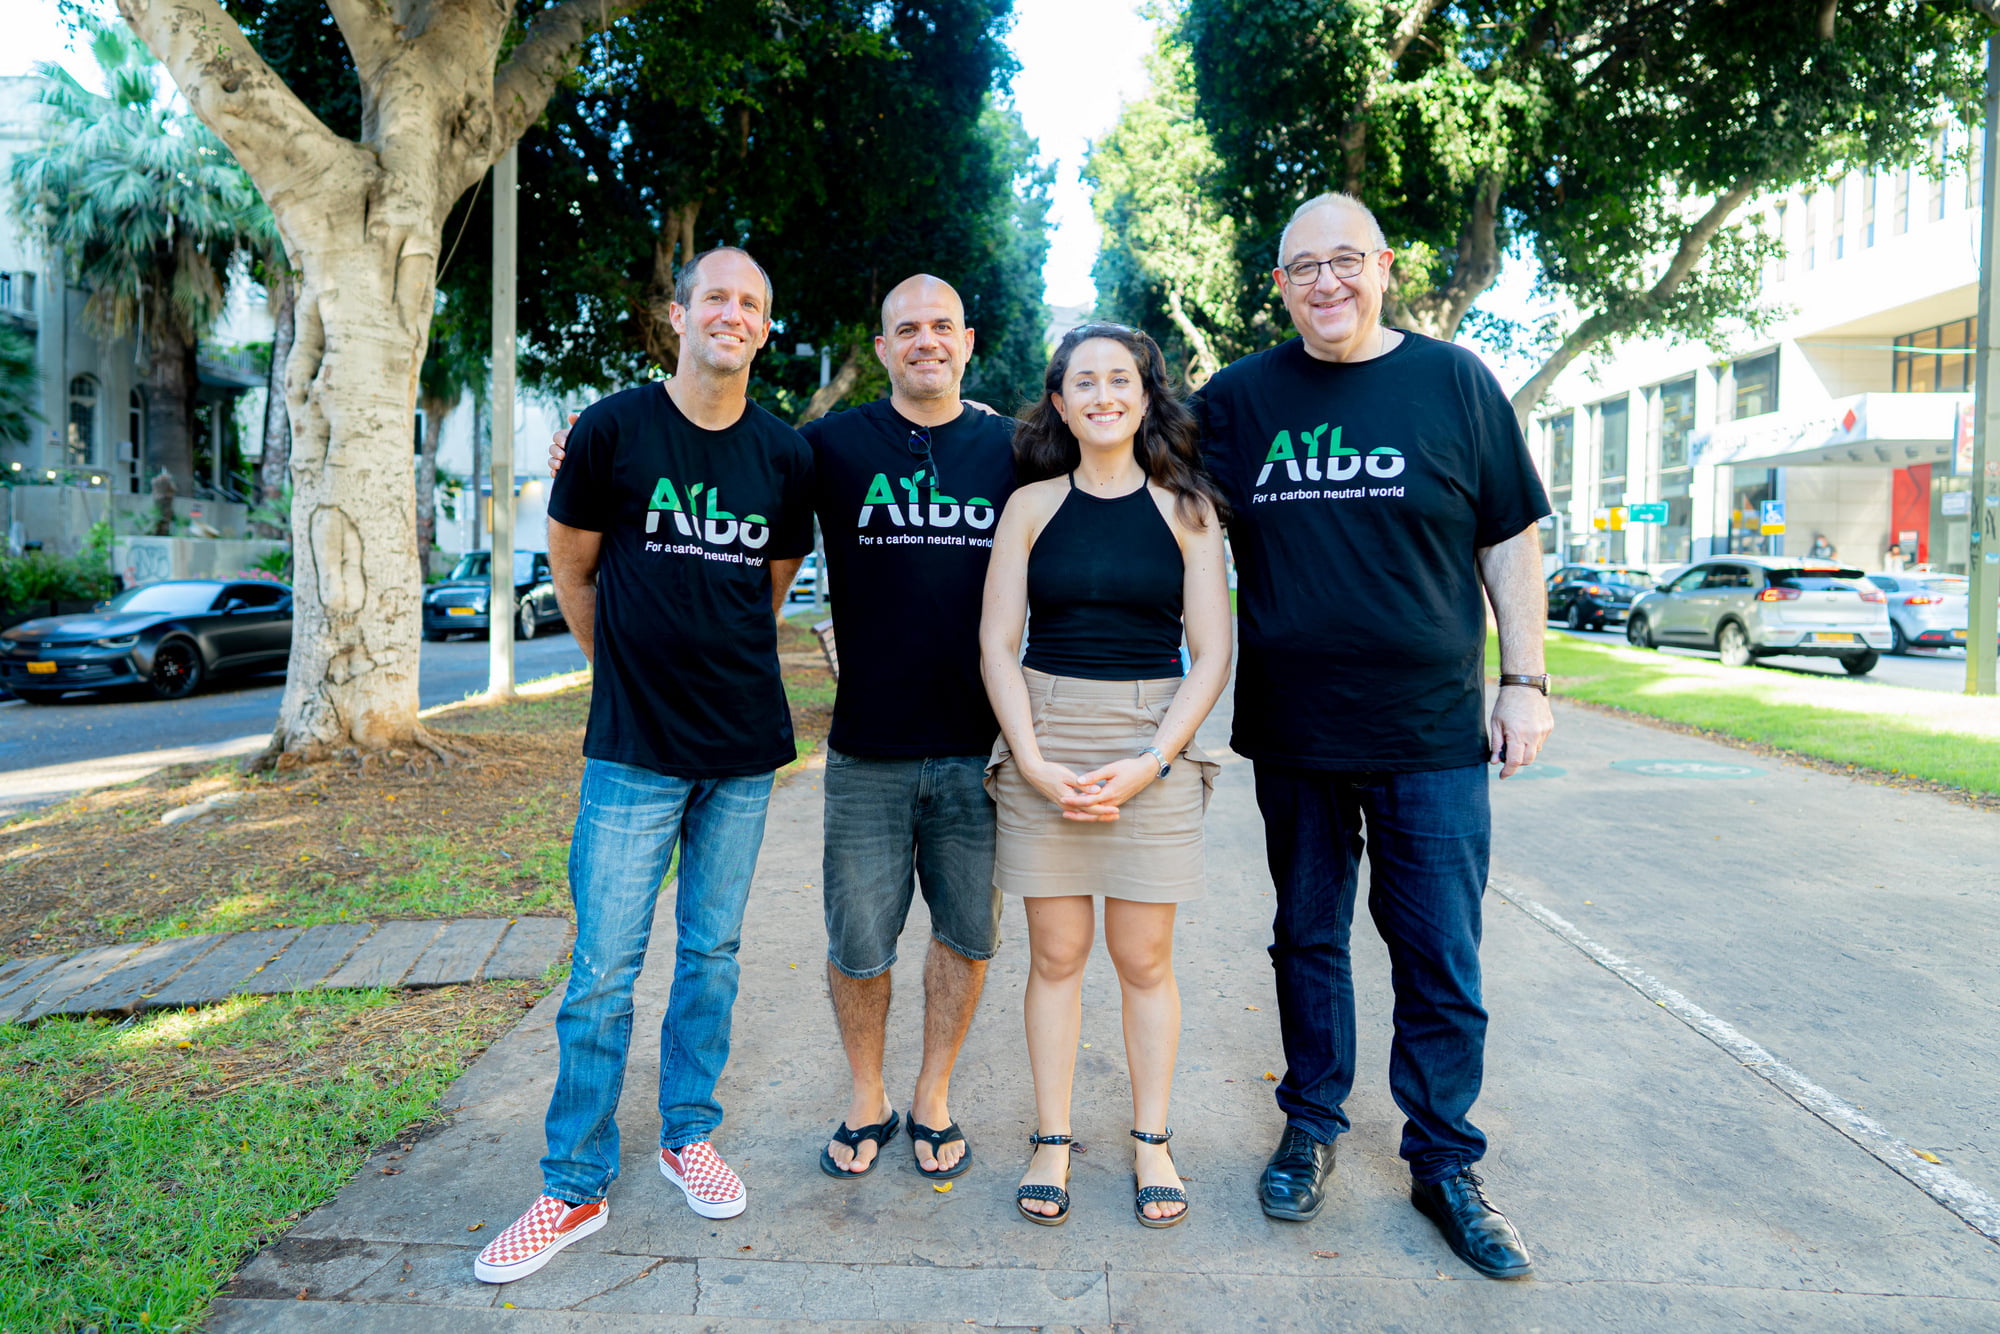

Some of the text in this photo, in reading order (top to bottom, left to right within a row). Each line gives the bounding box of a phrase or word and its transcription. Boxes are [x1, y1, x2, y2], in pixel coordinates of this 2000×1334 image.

[1252, 486, 1405, 504] For a carbon neutral world
[858, 533, 993, 548] For a carbon neutral world
[645, 541, 764, 567] For a carbo neutral orld
